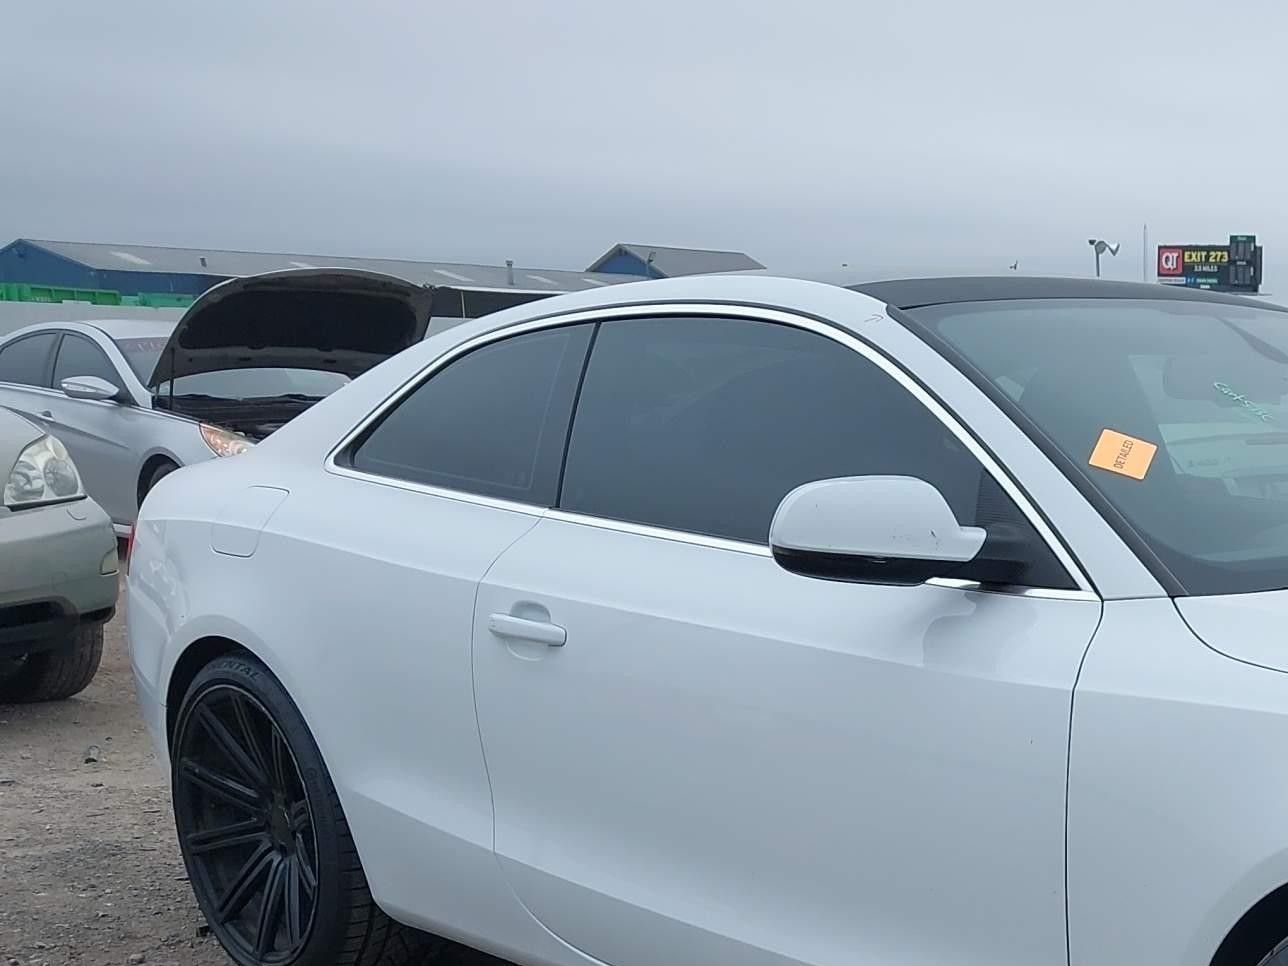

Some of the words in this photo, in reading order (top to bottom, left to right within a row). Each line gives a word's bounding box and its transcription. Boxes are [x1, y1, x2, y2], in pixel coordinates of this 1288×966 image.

[1161, 252, 1178, 270] QT
[1184, 251, 1207, 262] EXIT
[1209, 251, 1228, 262] 273
